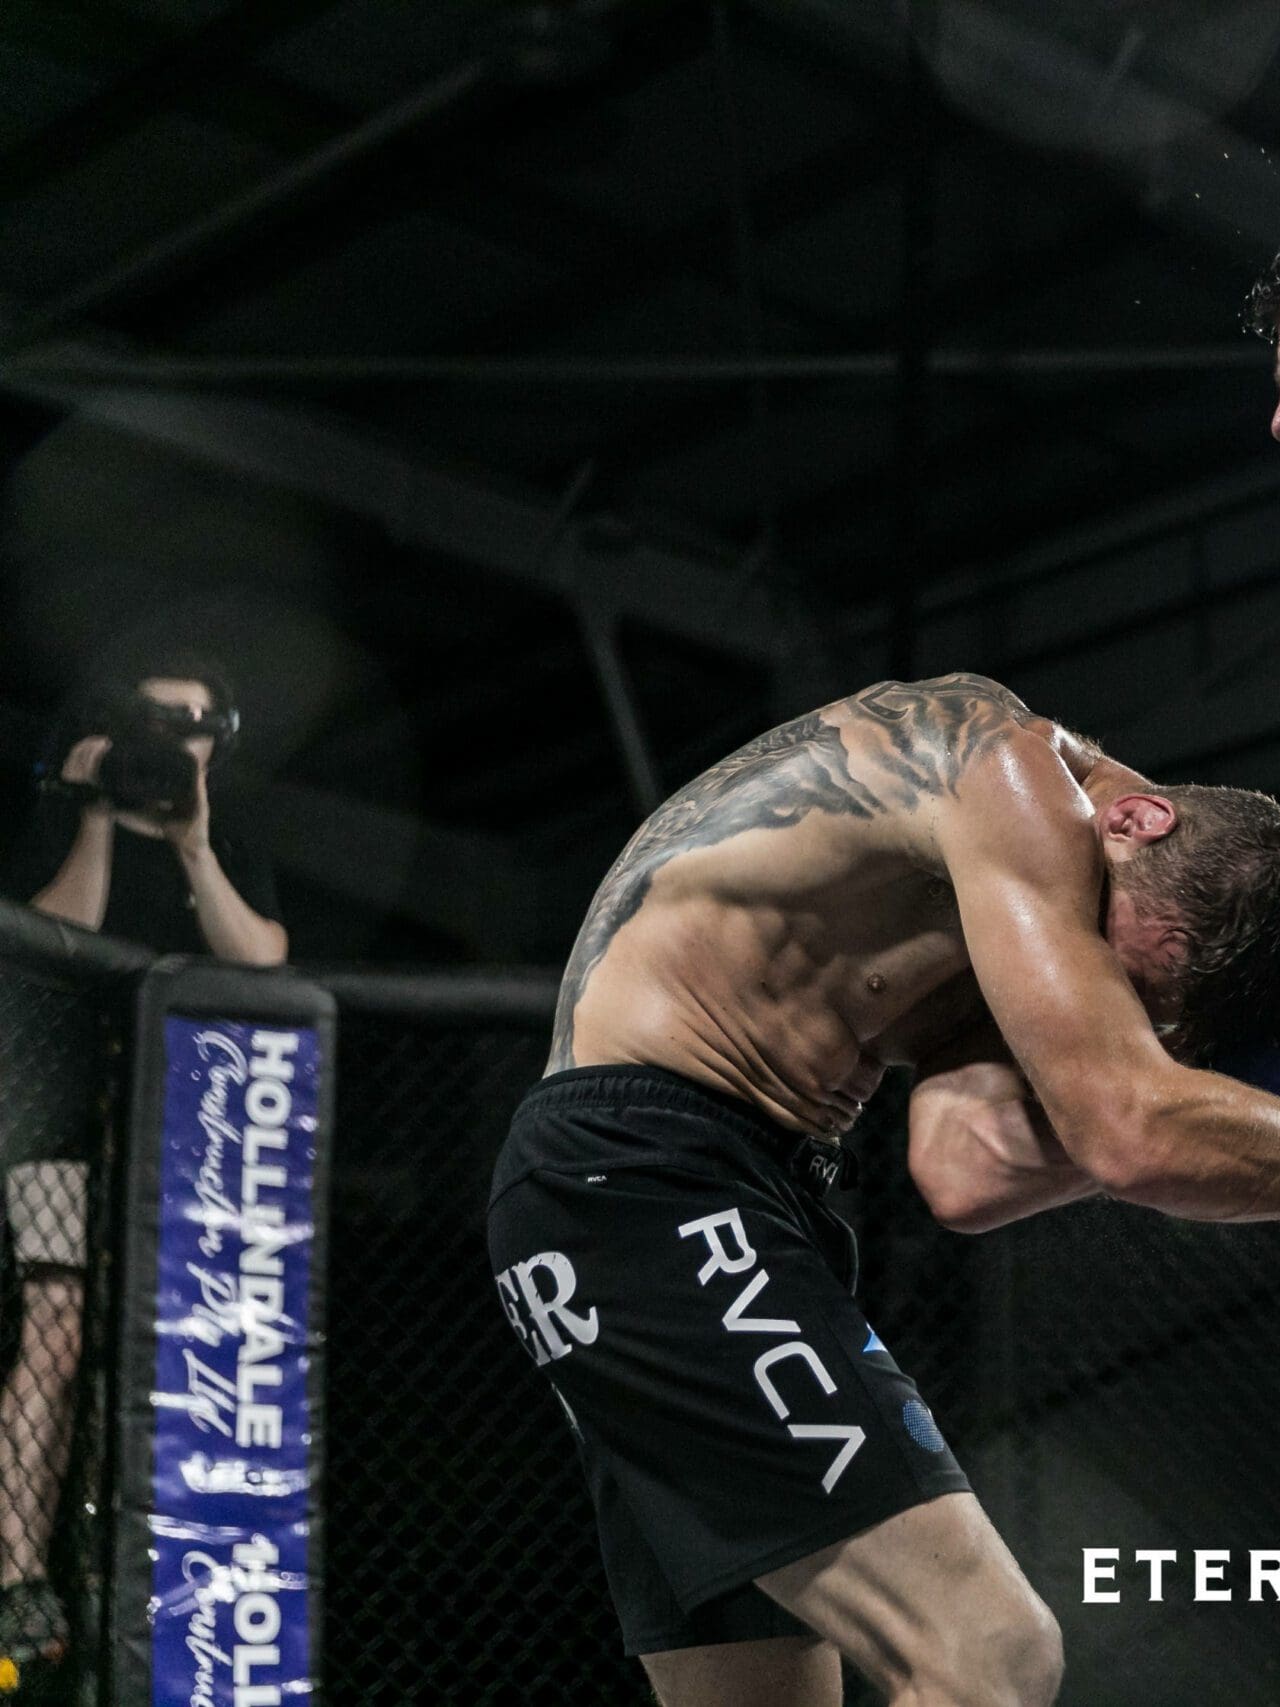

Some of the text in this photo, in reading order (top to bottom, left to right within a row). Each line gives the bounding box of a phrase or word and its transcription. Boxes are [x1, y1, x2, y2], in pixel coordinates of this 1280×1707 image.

[193, 1030, 249, 1258] Constructon
[236, 1029, 299, 1449] HOLLINDALE
[678, 1207, 867, 1494] RVCA
